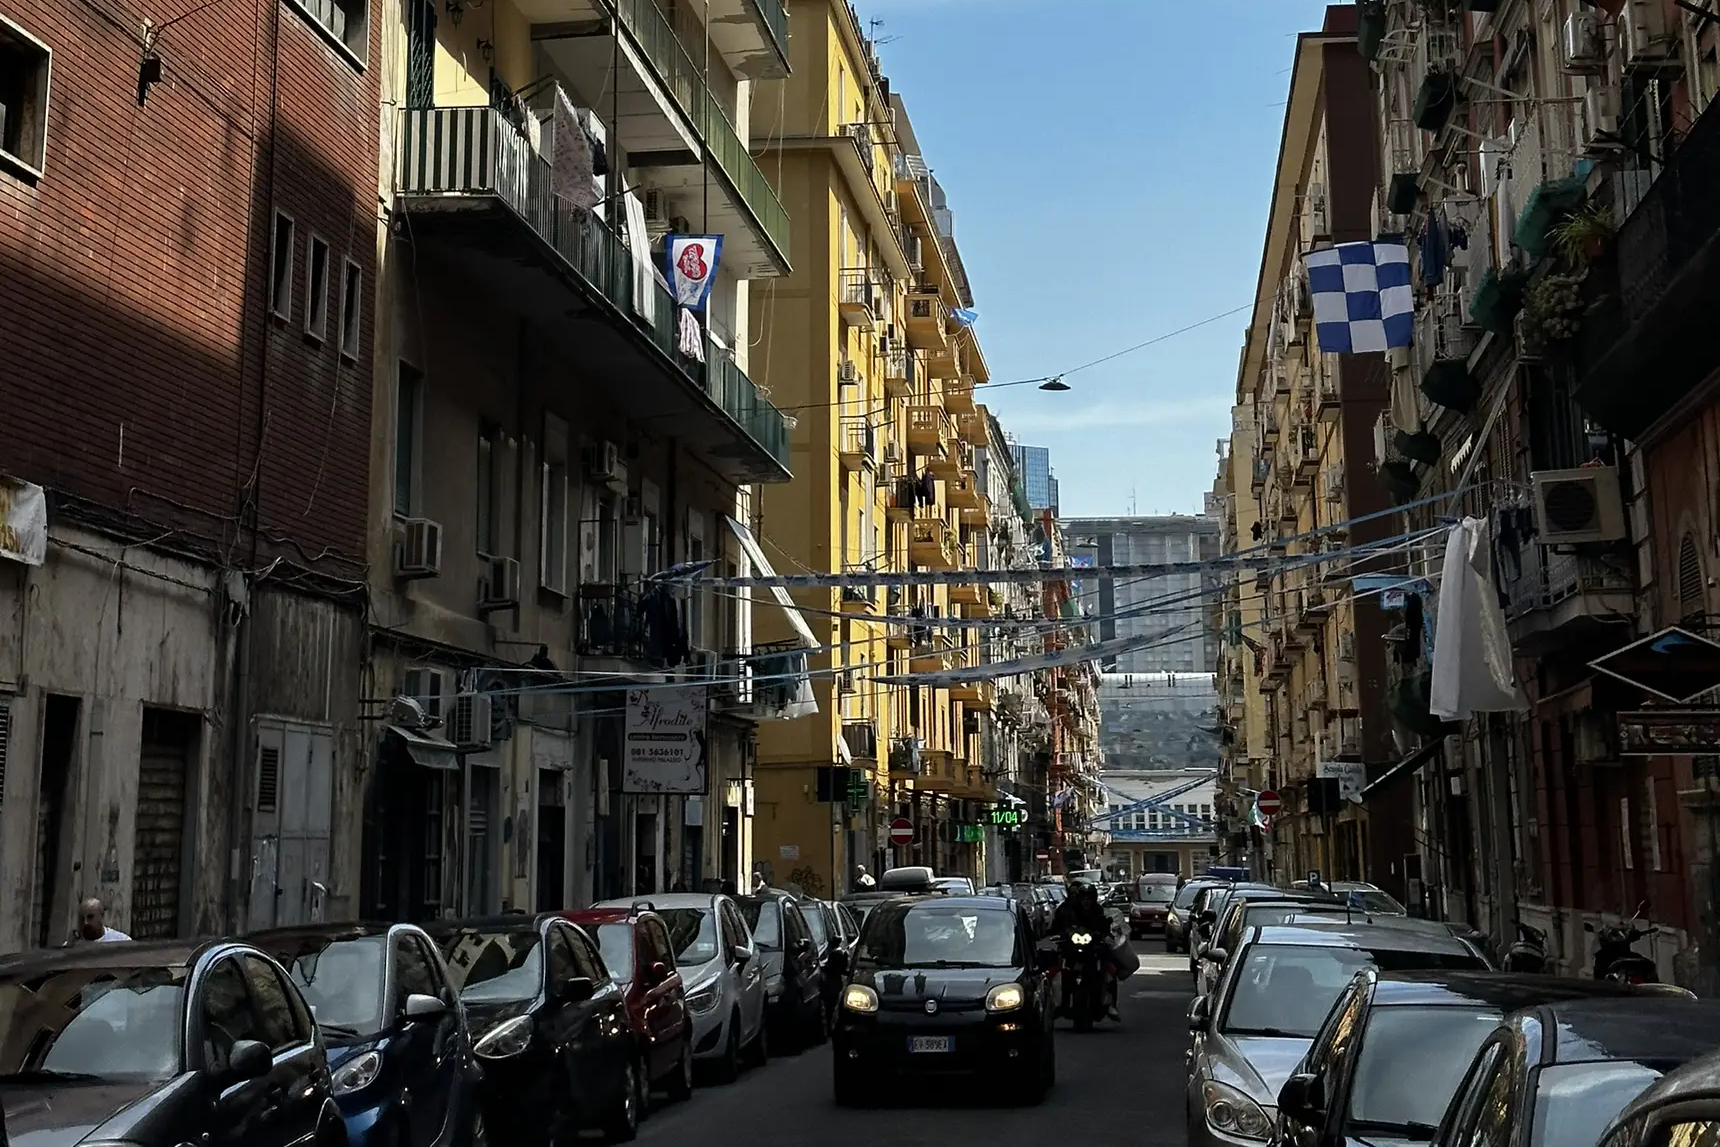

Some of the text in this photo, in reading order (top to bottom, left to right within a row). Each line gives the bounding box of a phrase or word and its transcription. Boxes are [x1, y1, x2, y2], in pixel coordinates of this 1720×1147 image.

[633, 703, 693, 730] Afrodite
[631, 748, 646, 756] 081
[991, 811, 1018, 824] 11/04
[1310, 872, 1318, 882] P
